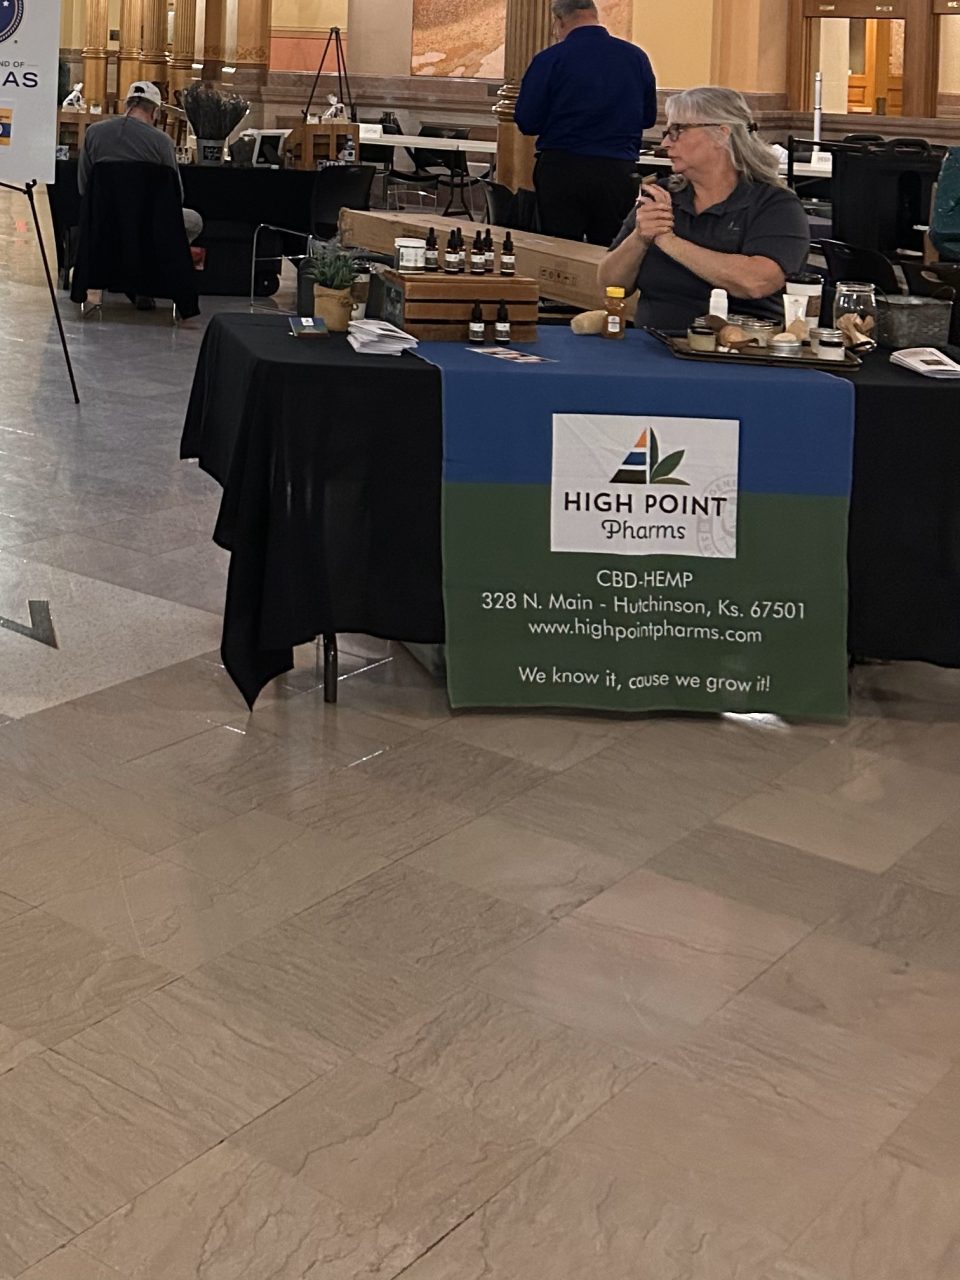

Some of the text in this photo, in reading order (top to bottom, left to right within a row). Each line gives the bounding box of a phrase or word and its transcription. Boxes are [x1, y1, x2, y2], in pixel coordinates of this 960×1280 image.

[564, 492, 727, 517] HIGH POINT
[601, 519, 686, 539] Pharms
[596, 569, 693, 589] CBD-HEMP
[481, 592, 517, 609] 328
[523, 592, 542, 609] N.
[548, 593, 593, 610] Main
[613, 595, 711, 618] Hutchinson,
[718, 599, 744, 617] Ks.
[750, 601, 805, 619] 67501
[528, 617, 762, 642] www.highpointpharms.com
[518, 666, 771, 693] We know it, cause we grow it!
